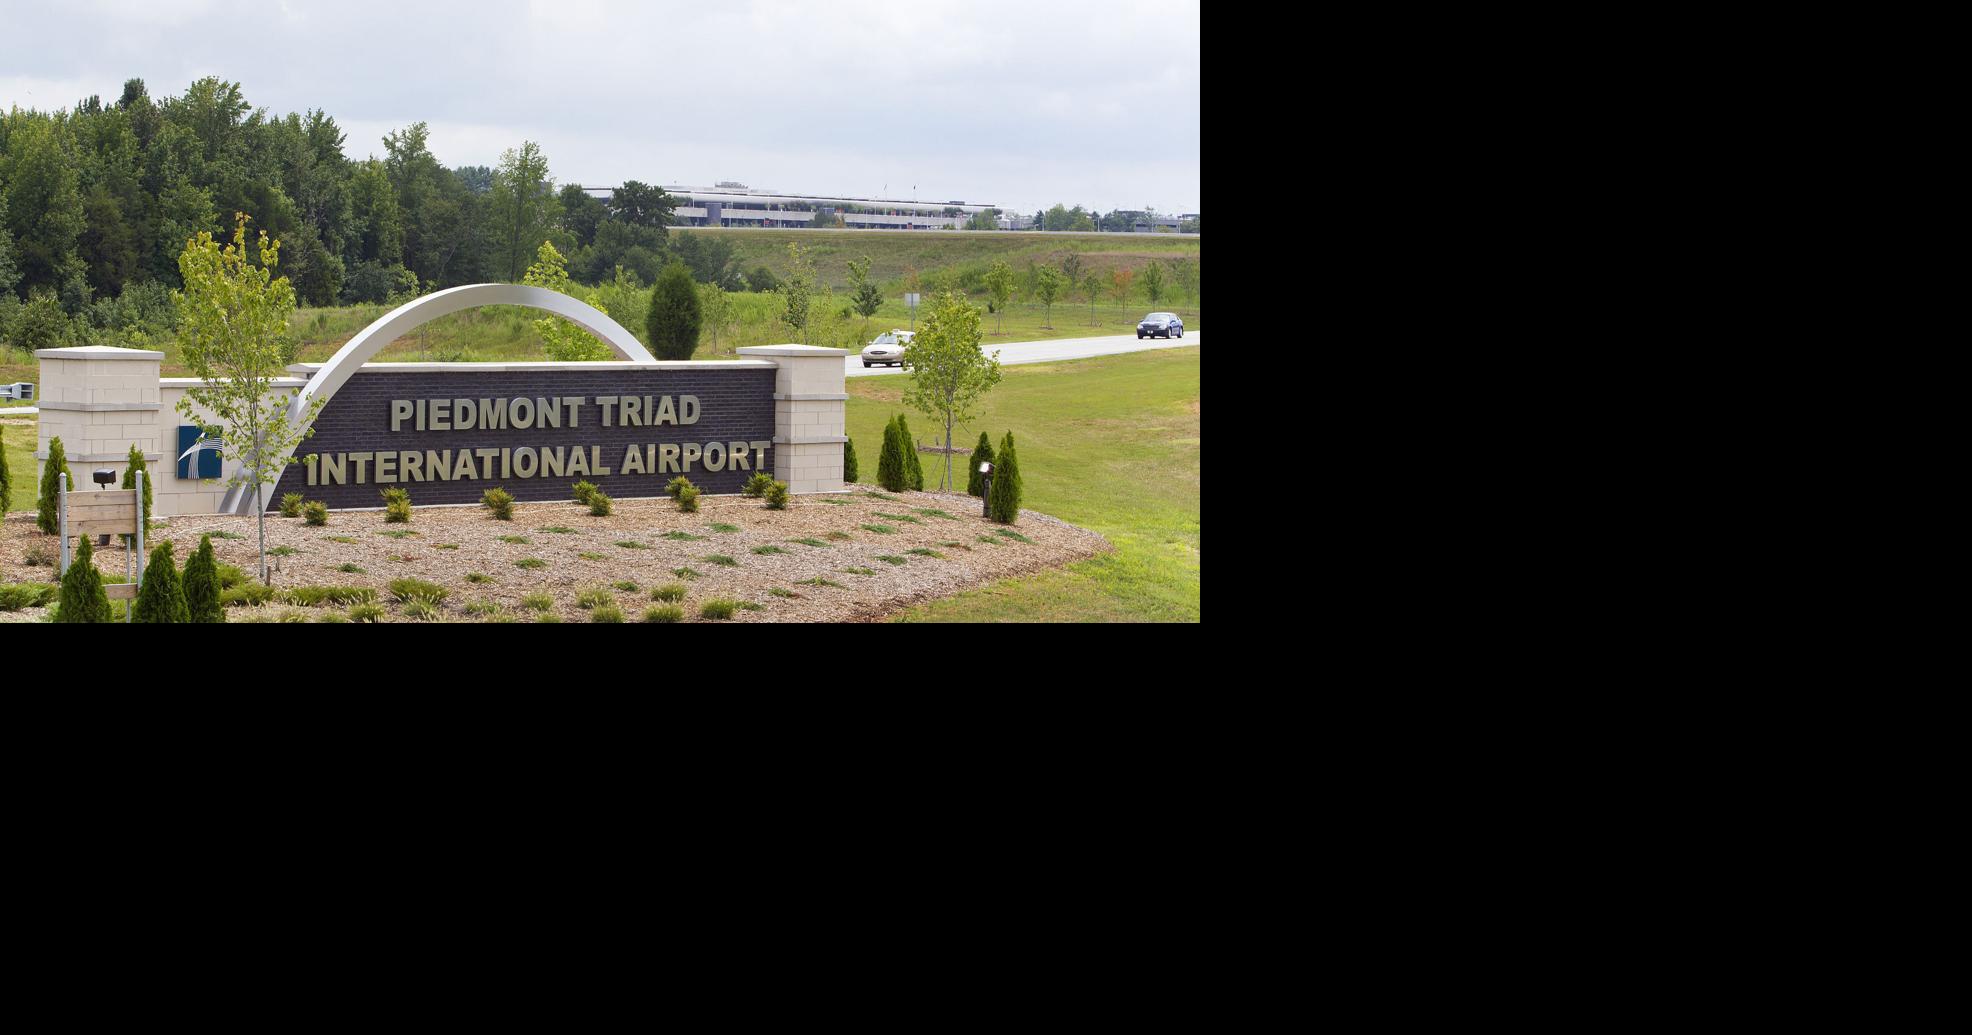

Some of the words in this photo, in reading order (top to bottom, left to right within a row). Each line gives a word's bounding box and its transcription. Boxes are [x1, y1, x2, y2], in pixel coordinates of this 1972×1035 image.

[390, 396, 585, 432] PIEDMONT
[595, 394, 701, 427] TRIAD
[306, 445, 612, 486] INTERNATIONAL
[621, 440, 771, 475] AIRPORT
